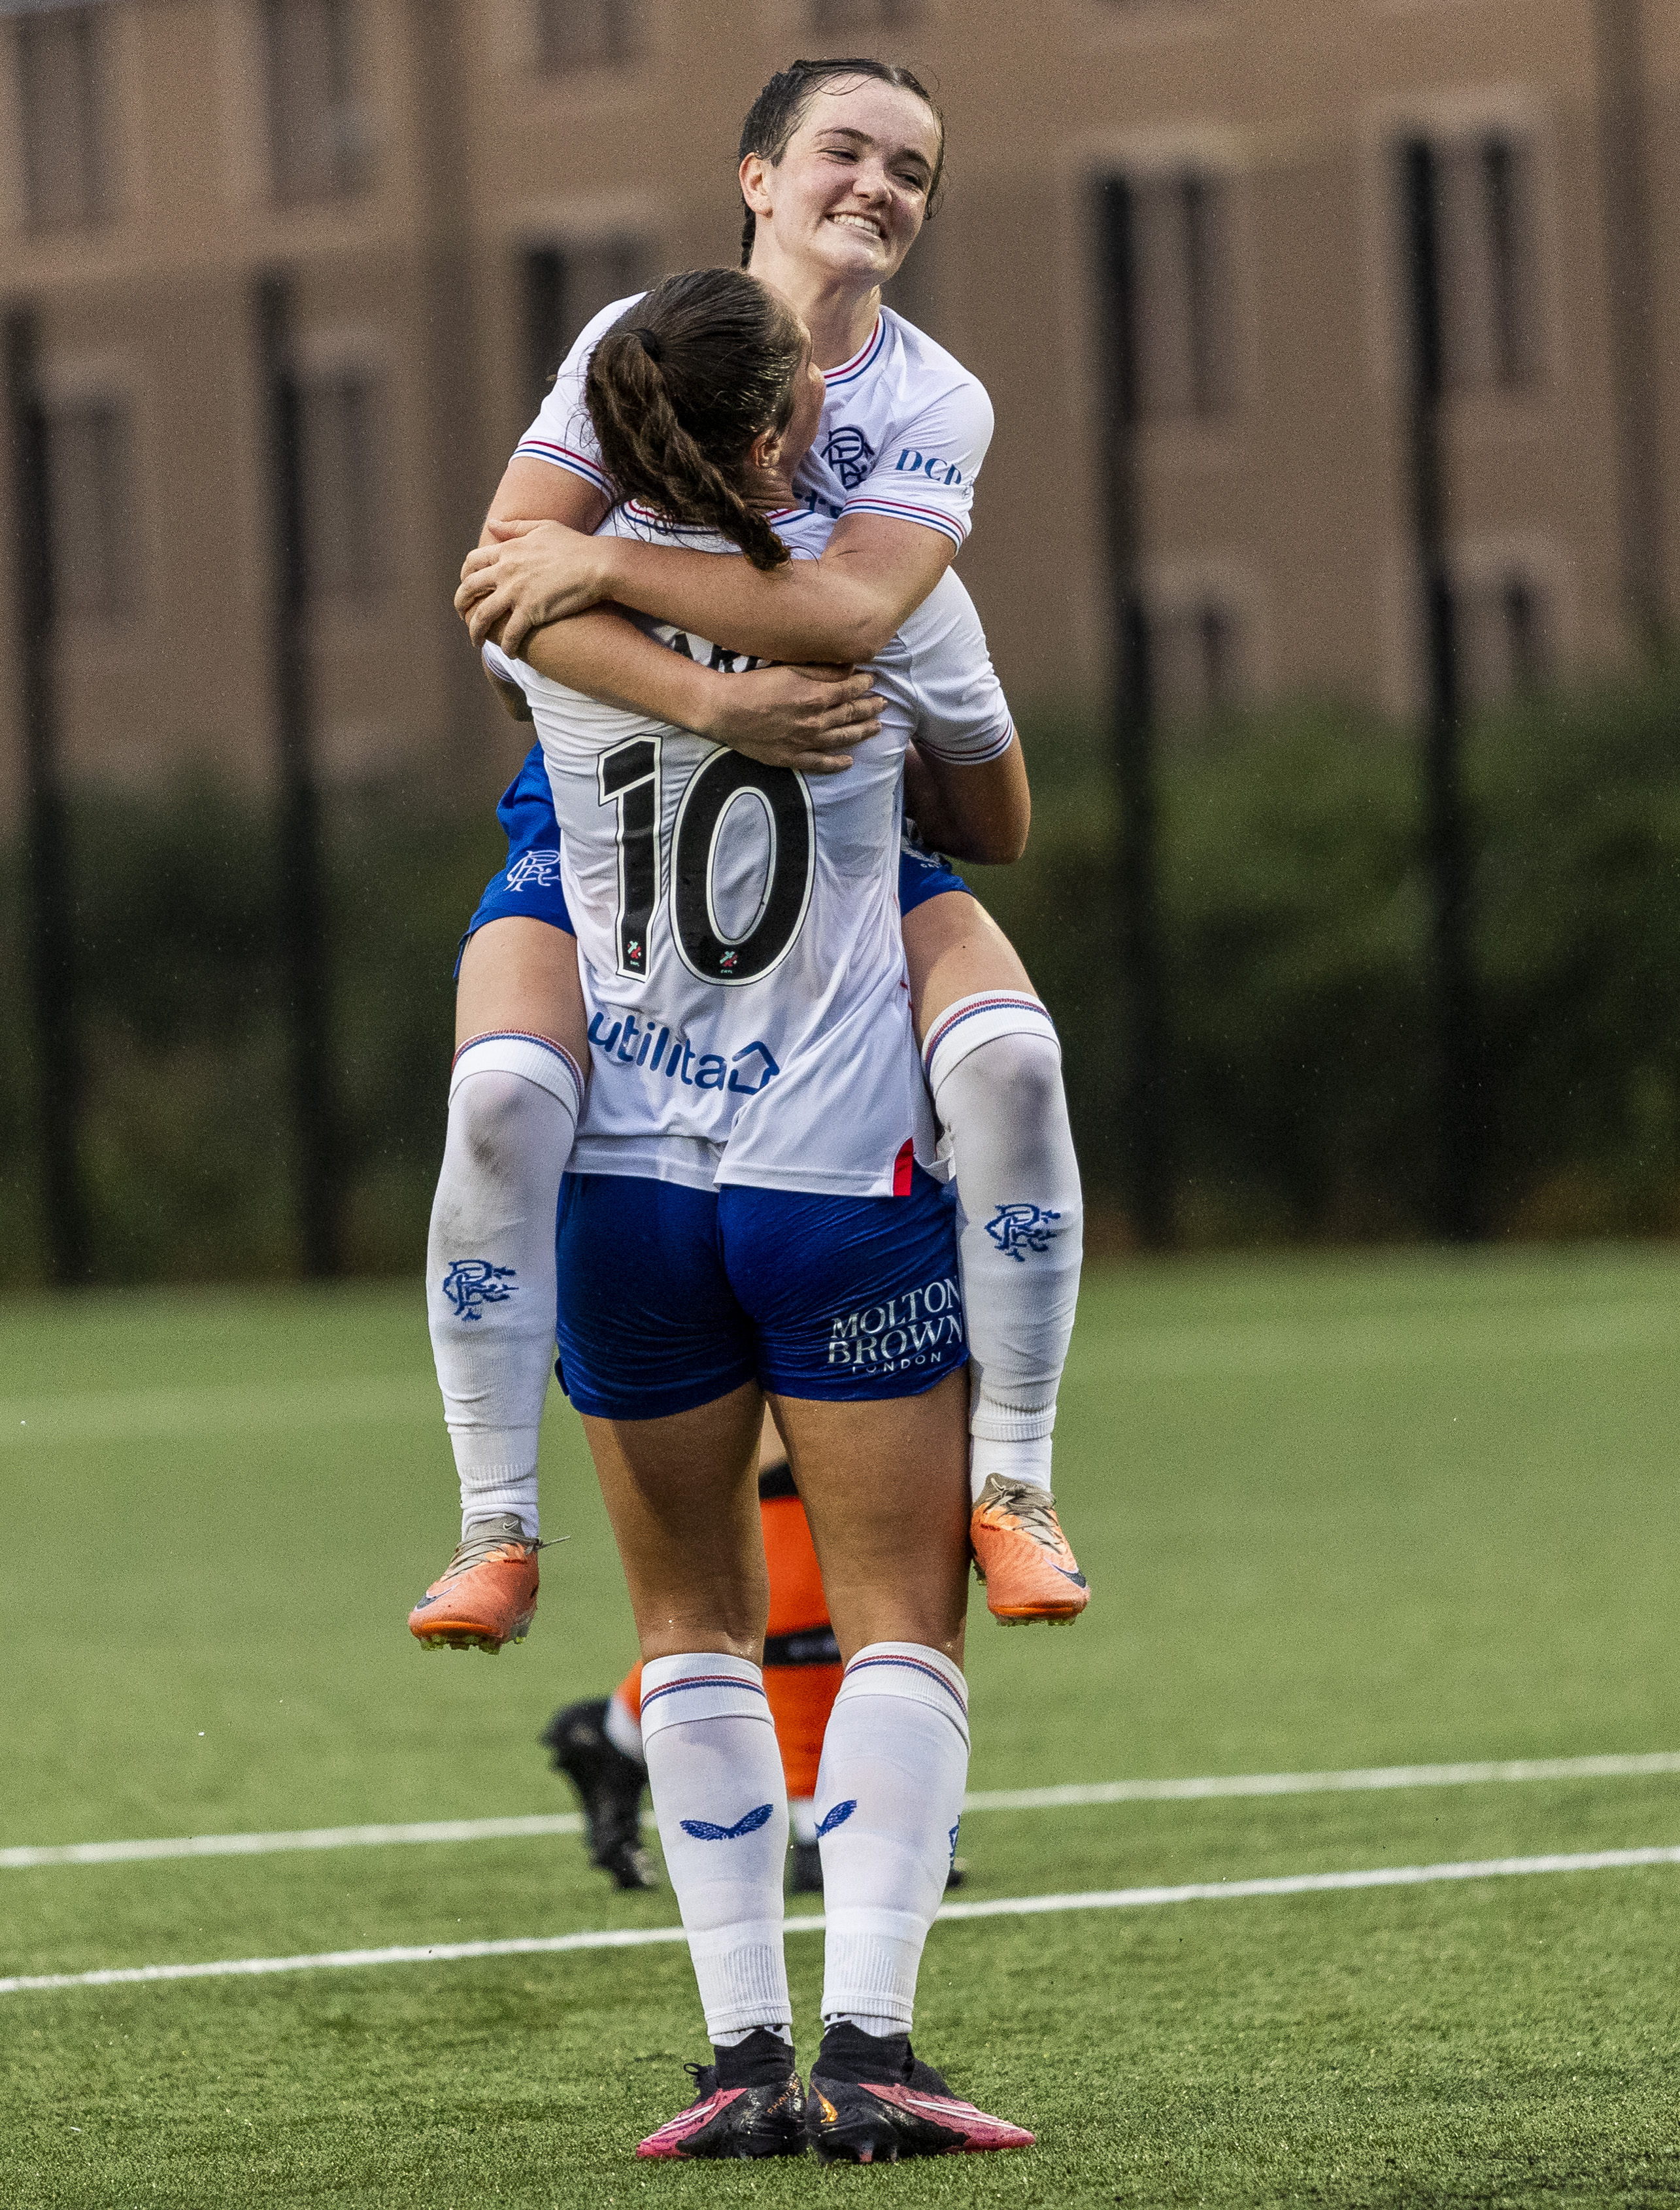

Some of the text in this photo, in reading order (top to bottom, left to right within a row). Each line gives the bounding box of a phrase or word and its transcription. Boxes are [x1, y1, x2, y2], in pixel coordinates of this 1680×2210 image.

[597, 734, 816, 987] 10
[588, 1012, 724, 1091] utilita
[827, 1312, 963, 1364] BROWN
[831, 1275, 961, 1338] MOLTON
